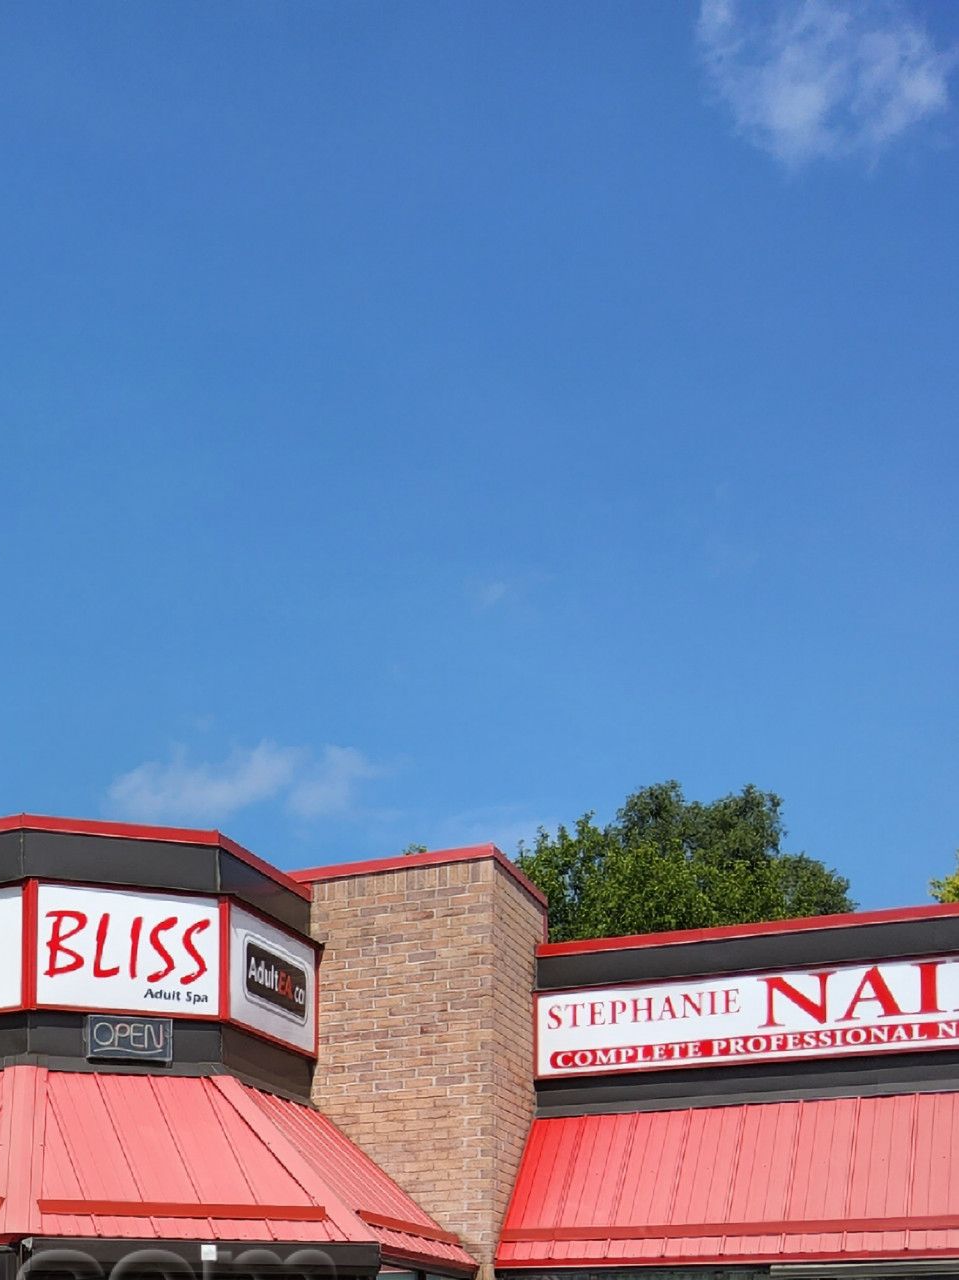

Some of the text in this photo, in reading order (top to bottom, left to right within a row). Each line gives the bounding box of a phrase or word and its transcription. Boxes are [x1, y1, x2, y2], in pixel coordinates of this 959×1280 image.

[43, 910, 211, 985] BLISS
[144, 988, 208, 1004] Adult Spa
[547, 961, 959, 1030] STEPHANIE NAI
[93, 1022, 163, 1049] OPEN
[556, 1042, 702, 1068] COMPLETE
[713, 1023, 928, 1056] PROFESSIONAL
